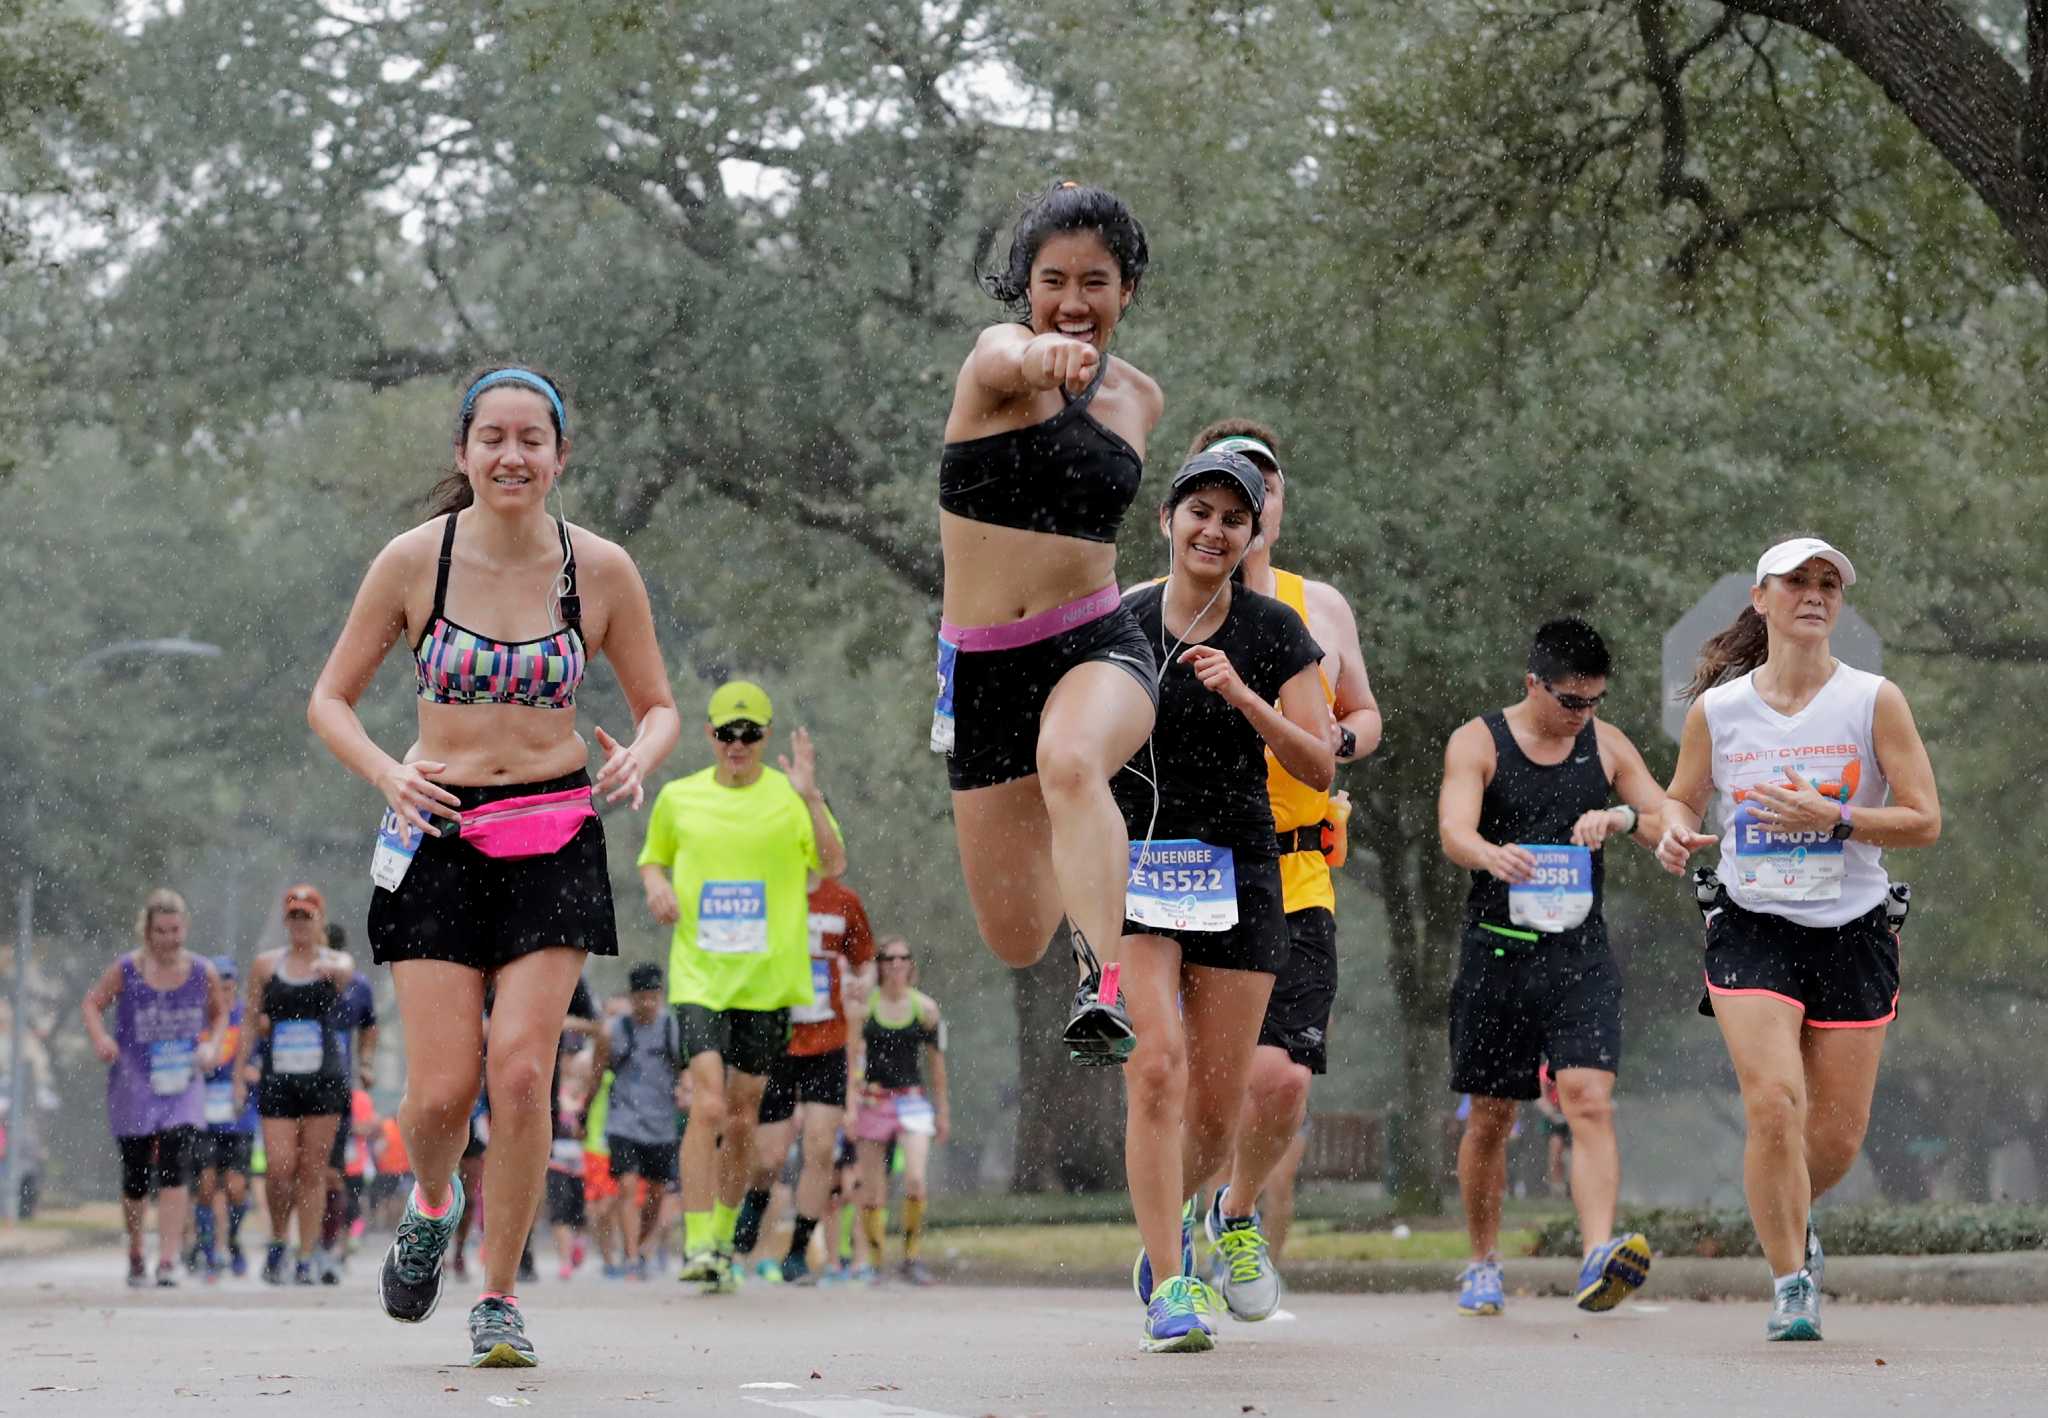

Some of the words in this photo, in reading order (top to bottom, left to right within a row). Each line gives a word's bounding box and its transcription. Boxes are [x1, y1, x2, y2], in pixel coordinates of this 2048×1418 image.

[1063, 603, 1095, 623] NIKE
[1778, 744, 1858, 758] CYPRESS
[1142, 849, 1212, 865] QUEENBEE
[1535, 853, 1569, 865] JUSTIN
[1132, 868, 1223, 893] E15522
[1529, 867, 1579, 885] 9581
[703, 898, 760, 914] E14127
